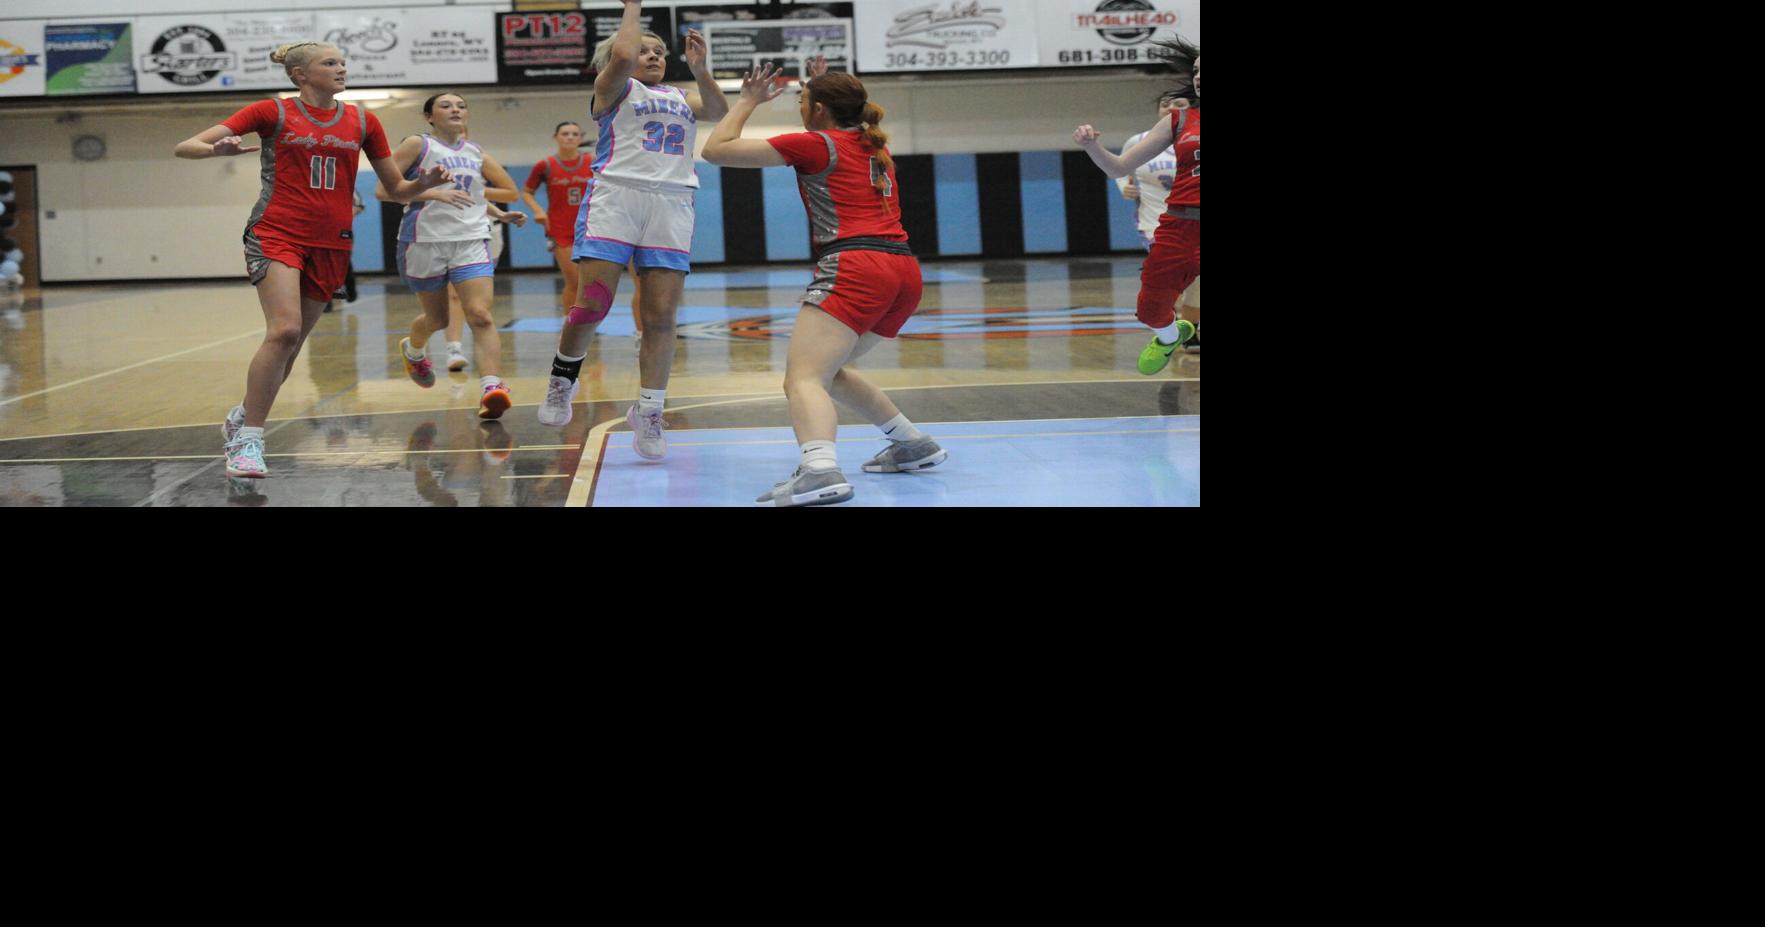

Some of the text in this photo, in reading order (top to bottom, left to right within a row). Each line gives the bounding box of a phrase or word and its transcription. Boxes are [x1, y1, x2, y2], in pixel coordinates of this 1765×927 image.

[502, 13, 587, 37] PT12
[1076, 12, 1177, 26] TRAILHEAD
[885, 51, 1011, 67] 304-393-3300
[281, 132, 319, 149] Lady
[641, 120, 686, 156] 32
[310, 155, 337, 190] 11
[567, 187, 581, 206] 5
